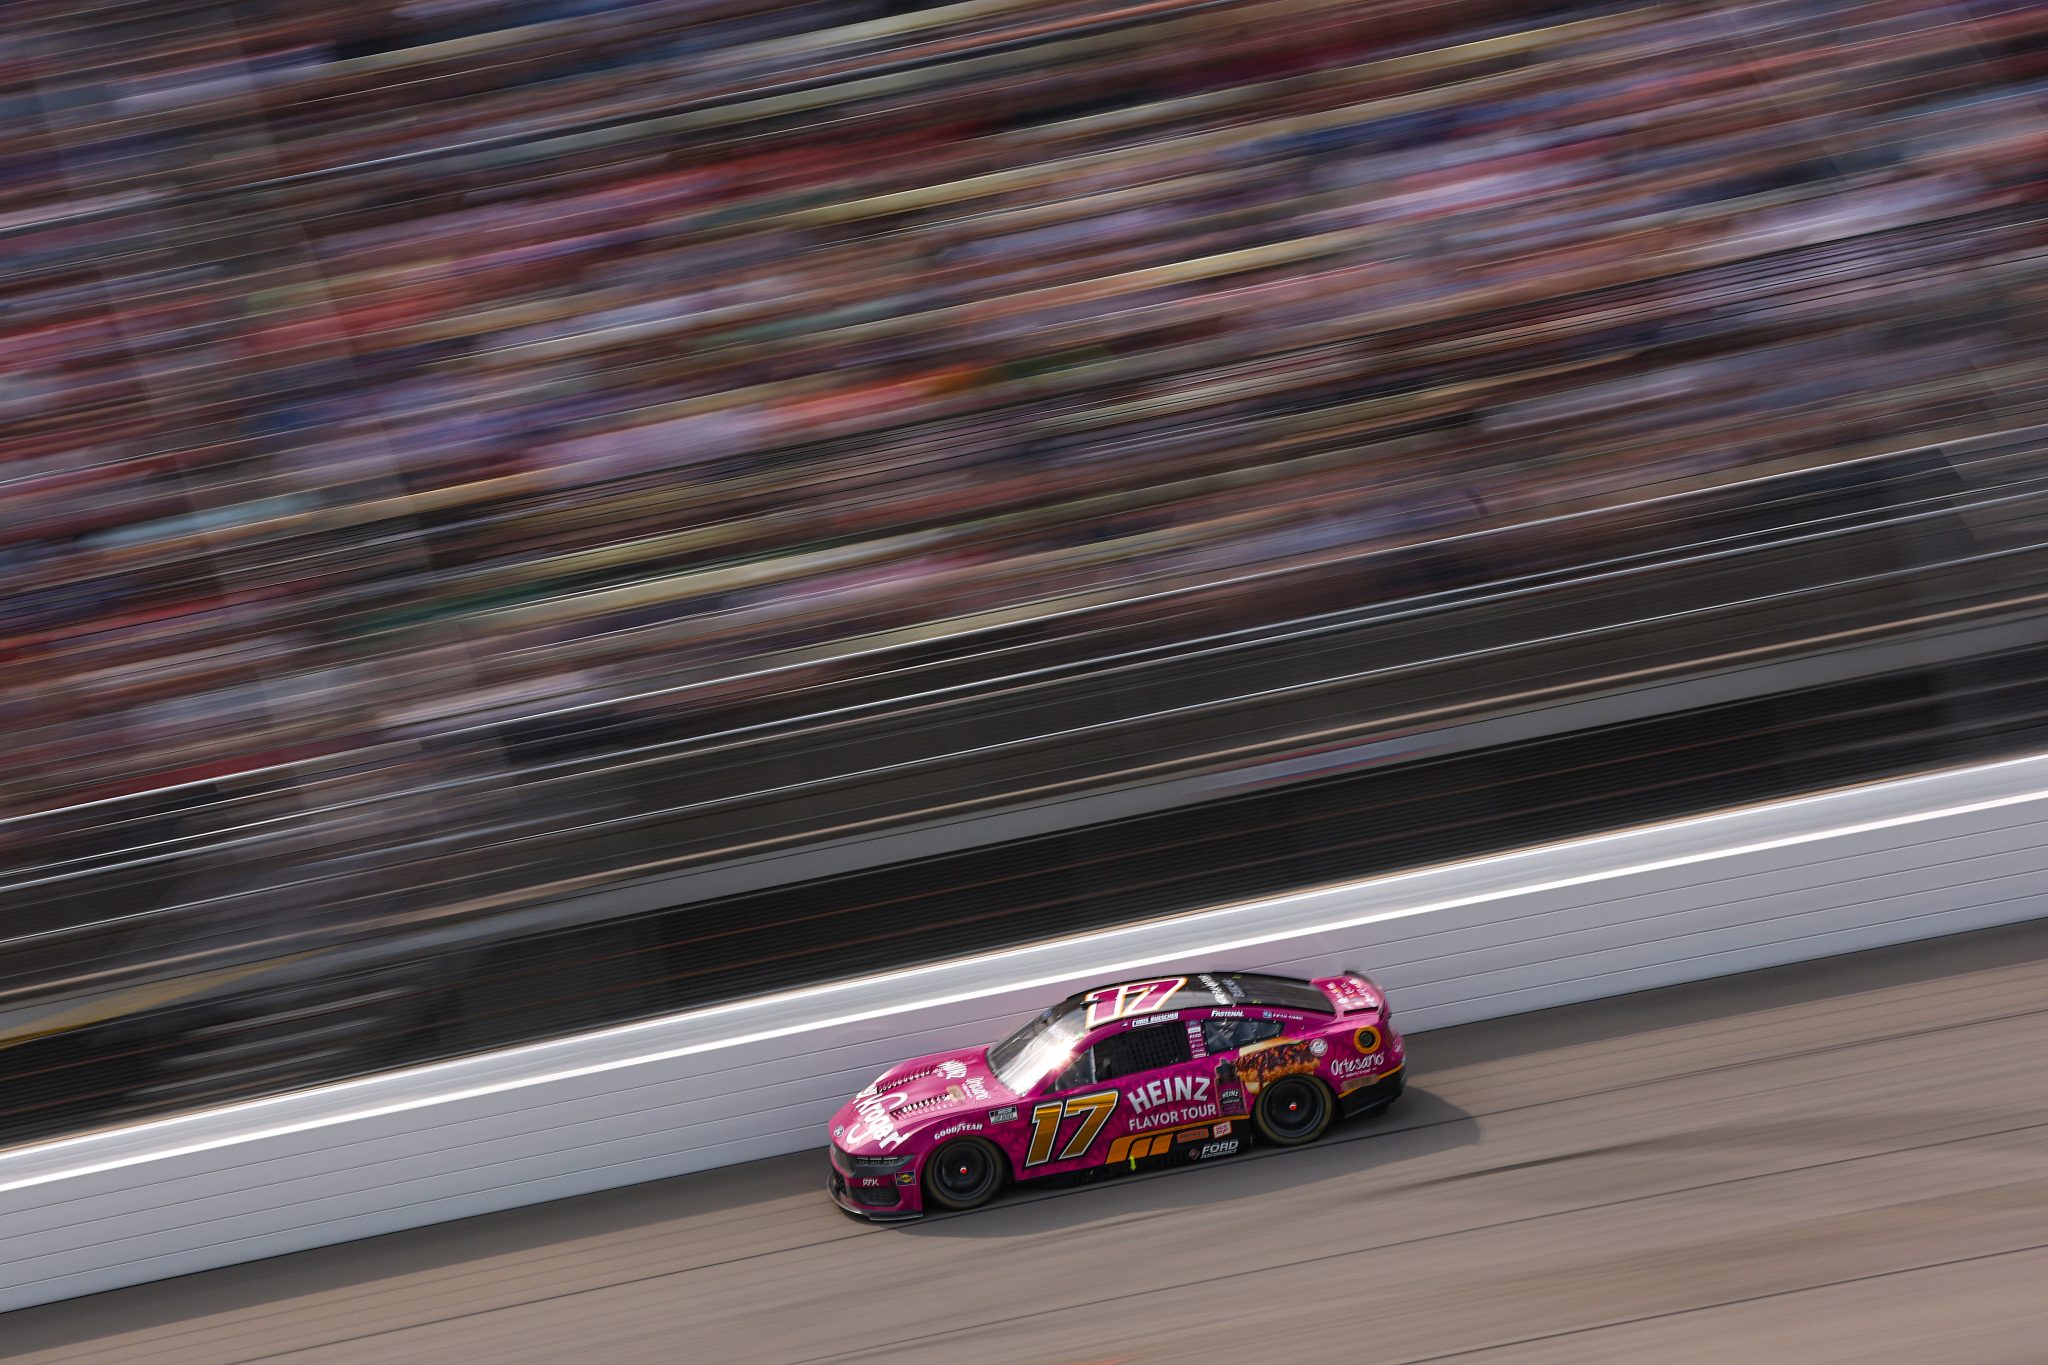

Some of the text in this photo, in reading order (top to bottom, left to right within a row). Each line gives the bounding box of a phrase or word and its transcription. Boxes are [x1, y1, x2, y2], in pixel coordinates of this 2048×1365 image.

[1085, 977, 1188, 1029] 17
[1211, 1009, 1244, 1017] FASTENAL
[1127, 1077, 1210, 1114] HEINZ
[847, 1092, 909, 1149] Kroger
[934, 1123, 983, 1140] GOODYEAR
[1025, 1090, 1119, 1167] 17
[1129, 1104, 1216, 1131] FLAVOR TOUR
[1202, 1141, 1239, 1155] FORD
